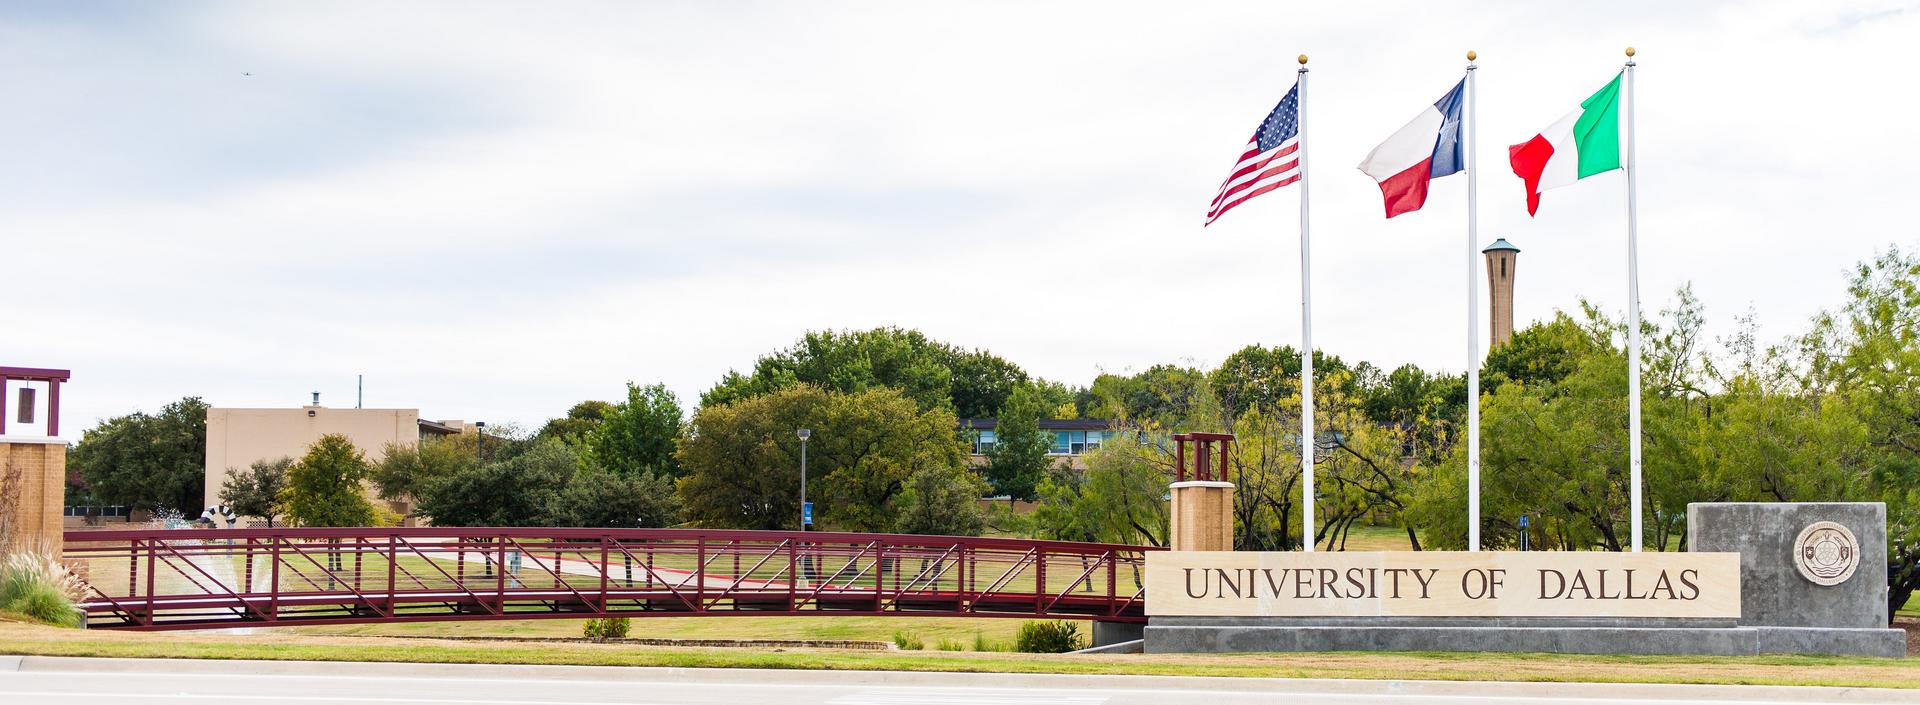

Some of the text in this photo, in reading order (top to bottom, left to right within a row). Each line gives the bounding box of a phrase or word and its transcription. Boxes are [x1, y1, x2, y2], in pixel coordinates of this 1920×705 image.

[1183, 568, 1701, 601] UNIVERSITY OF DALLAS
